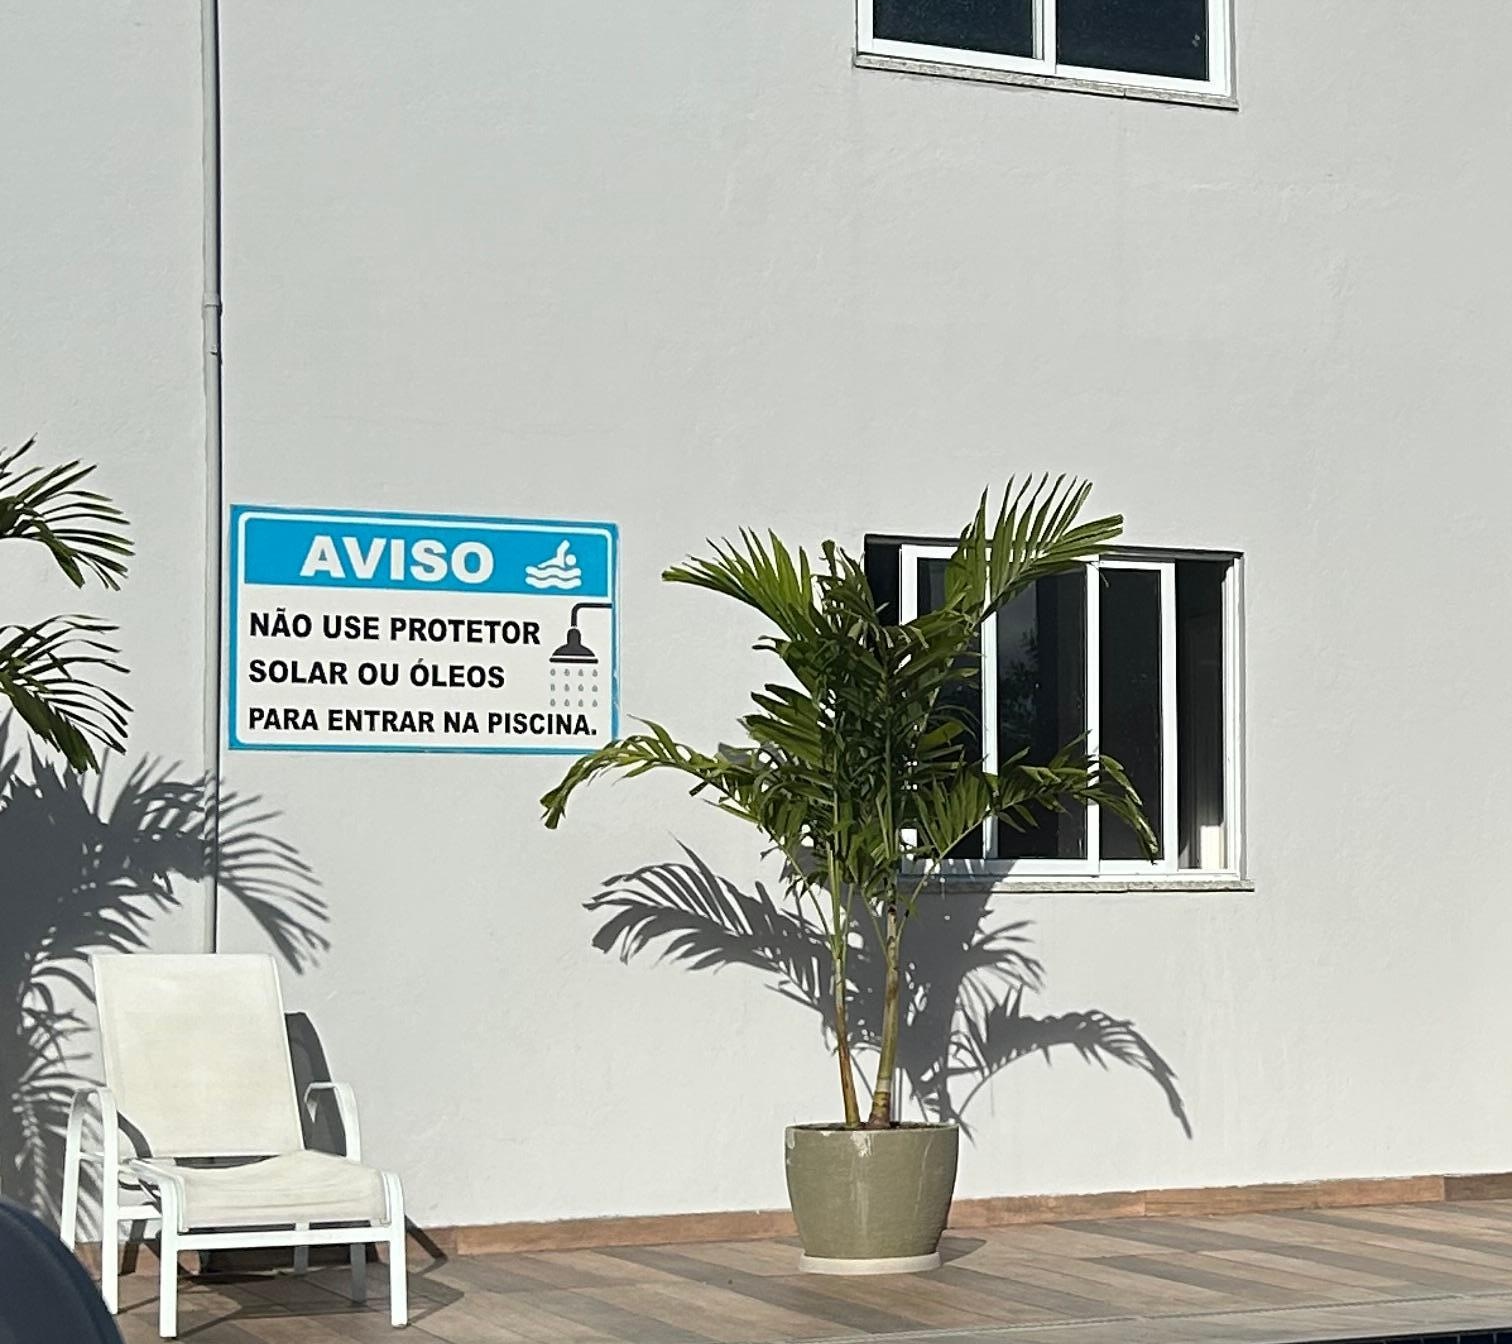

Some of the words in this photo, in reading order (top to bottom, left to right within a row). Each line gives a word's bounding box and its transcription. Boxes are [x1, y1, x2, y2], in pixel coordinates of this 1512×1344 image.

[299, 535, 495, 584] AVISO
[249, 607, 313, 638] NÃO
[323, 614, 380, 640] USE
[390, 617, 541, 645] PROTETOR
[248, 659, 348, 685] SOLAR
[358, 662, 399, 687] OU
[409, 657, 505, 689] ÓLEOS
[249, 707, 319, 731] PARA
[327, 709, 435, 733] ENTRAR
[443, 711, 480, 734] NA
[488, 712, 597, 736] PISCINA.
